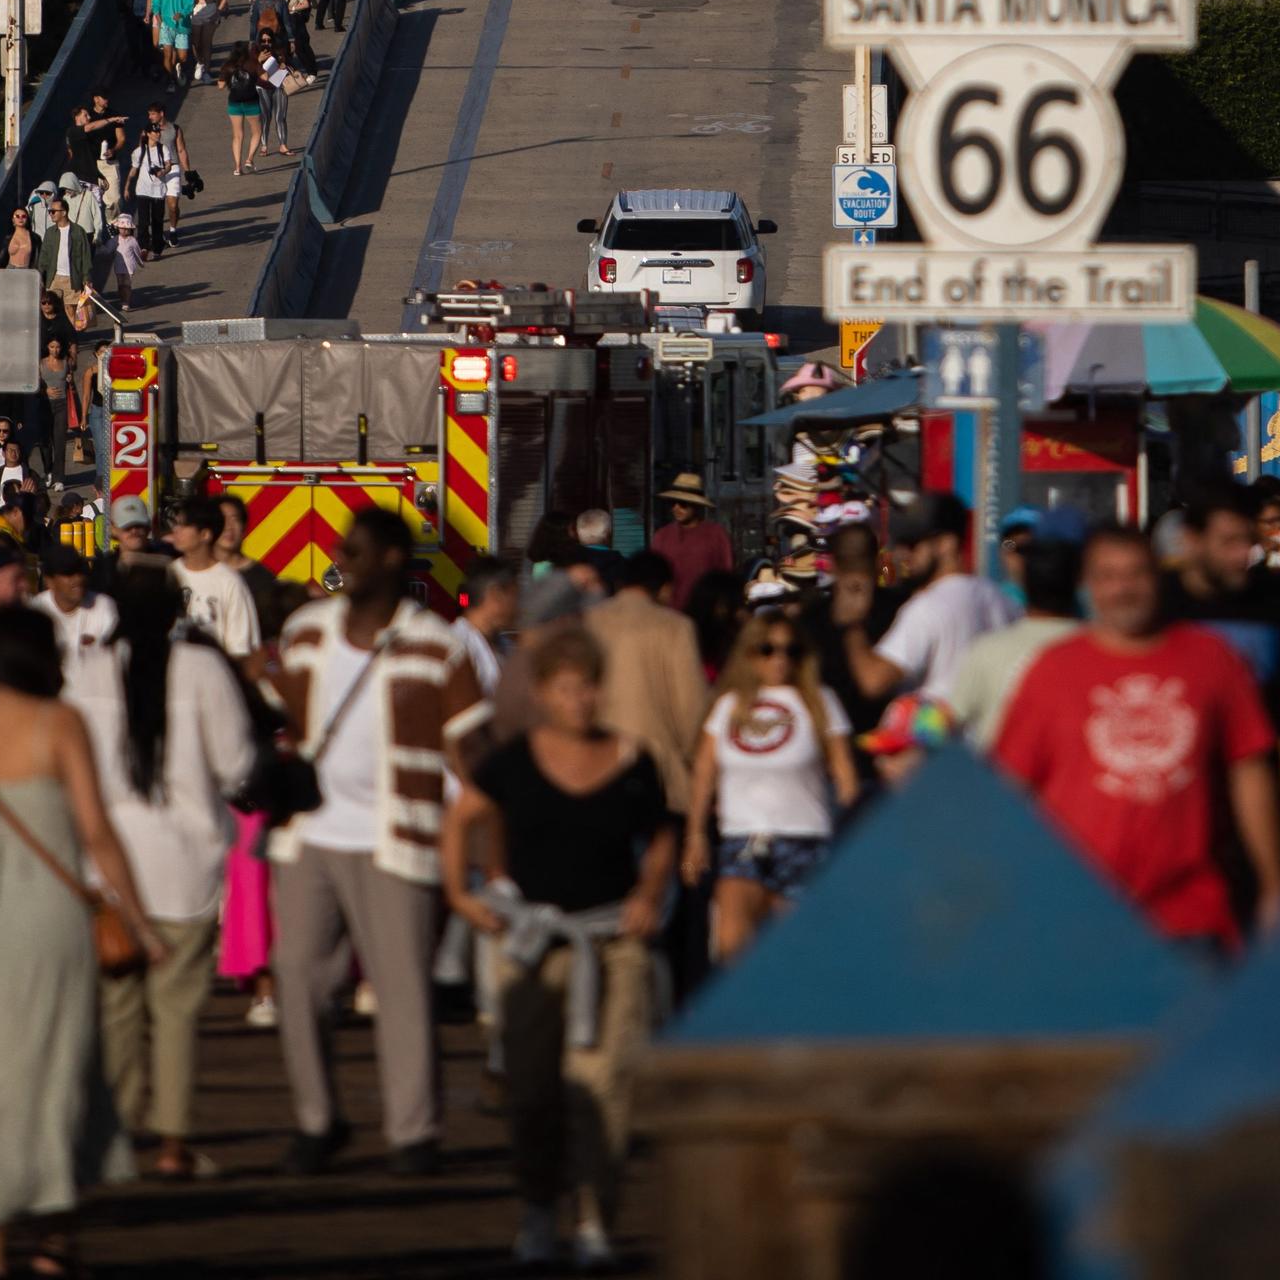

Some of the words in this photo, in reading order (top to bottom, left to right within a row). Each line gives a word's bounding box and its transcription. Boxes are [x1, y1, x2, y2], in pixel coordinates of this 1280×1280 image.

[841, 153, 891, 163] SPED
[936, 81, 1085, 217] 66
[842, 198, 887, 208] EVACUATION
[853, 209, 876, 218] ROUTE
[847, 257, 927, 304] End
[942, 256, 988, 302] of
[1001, 257, 1068, 304] the
[1083, 258, 1173, 305] Trail
[114, 425, 148, 466] 2
